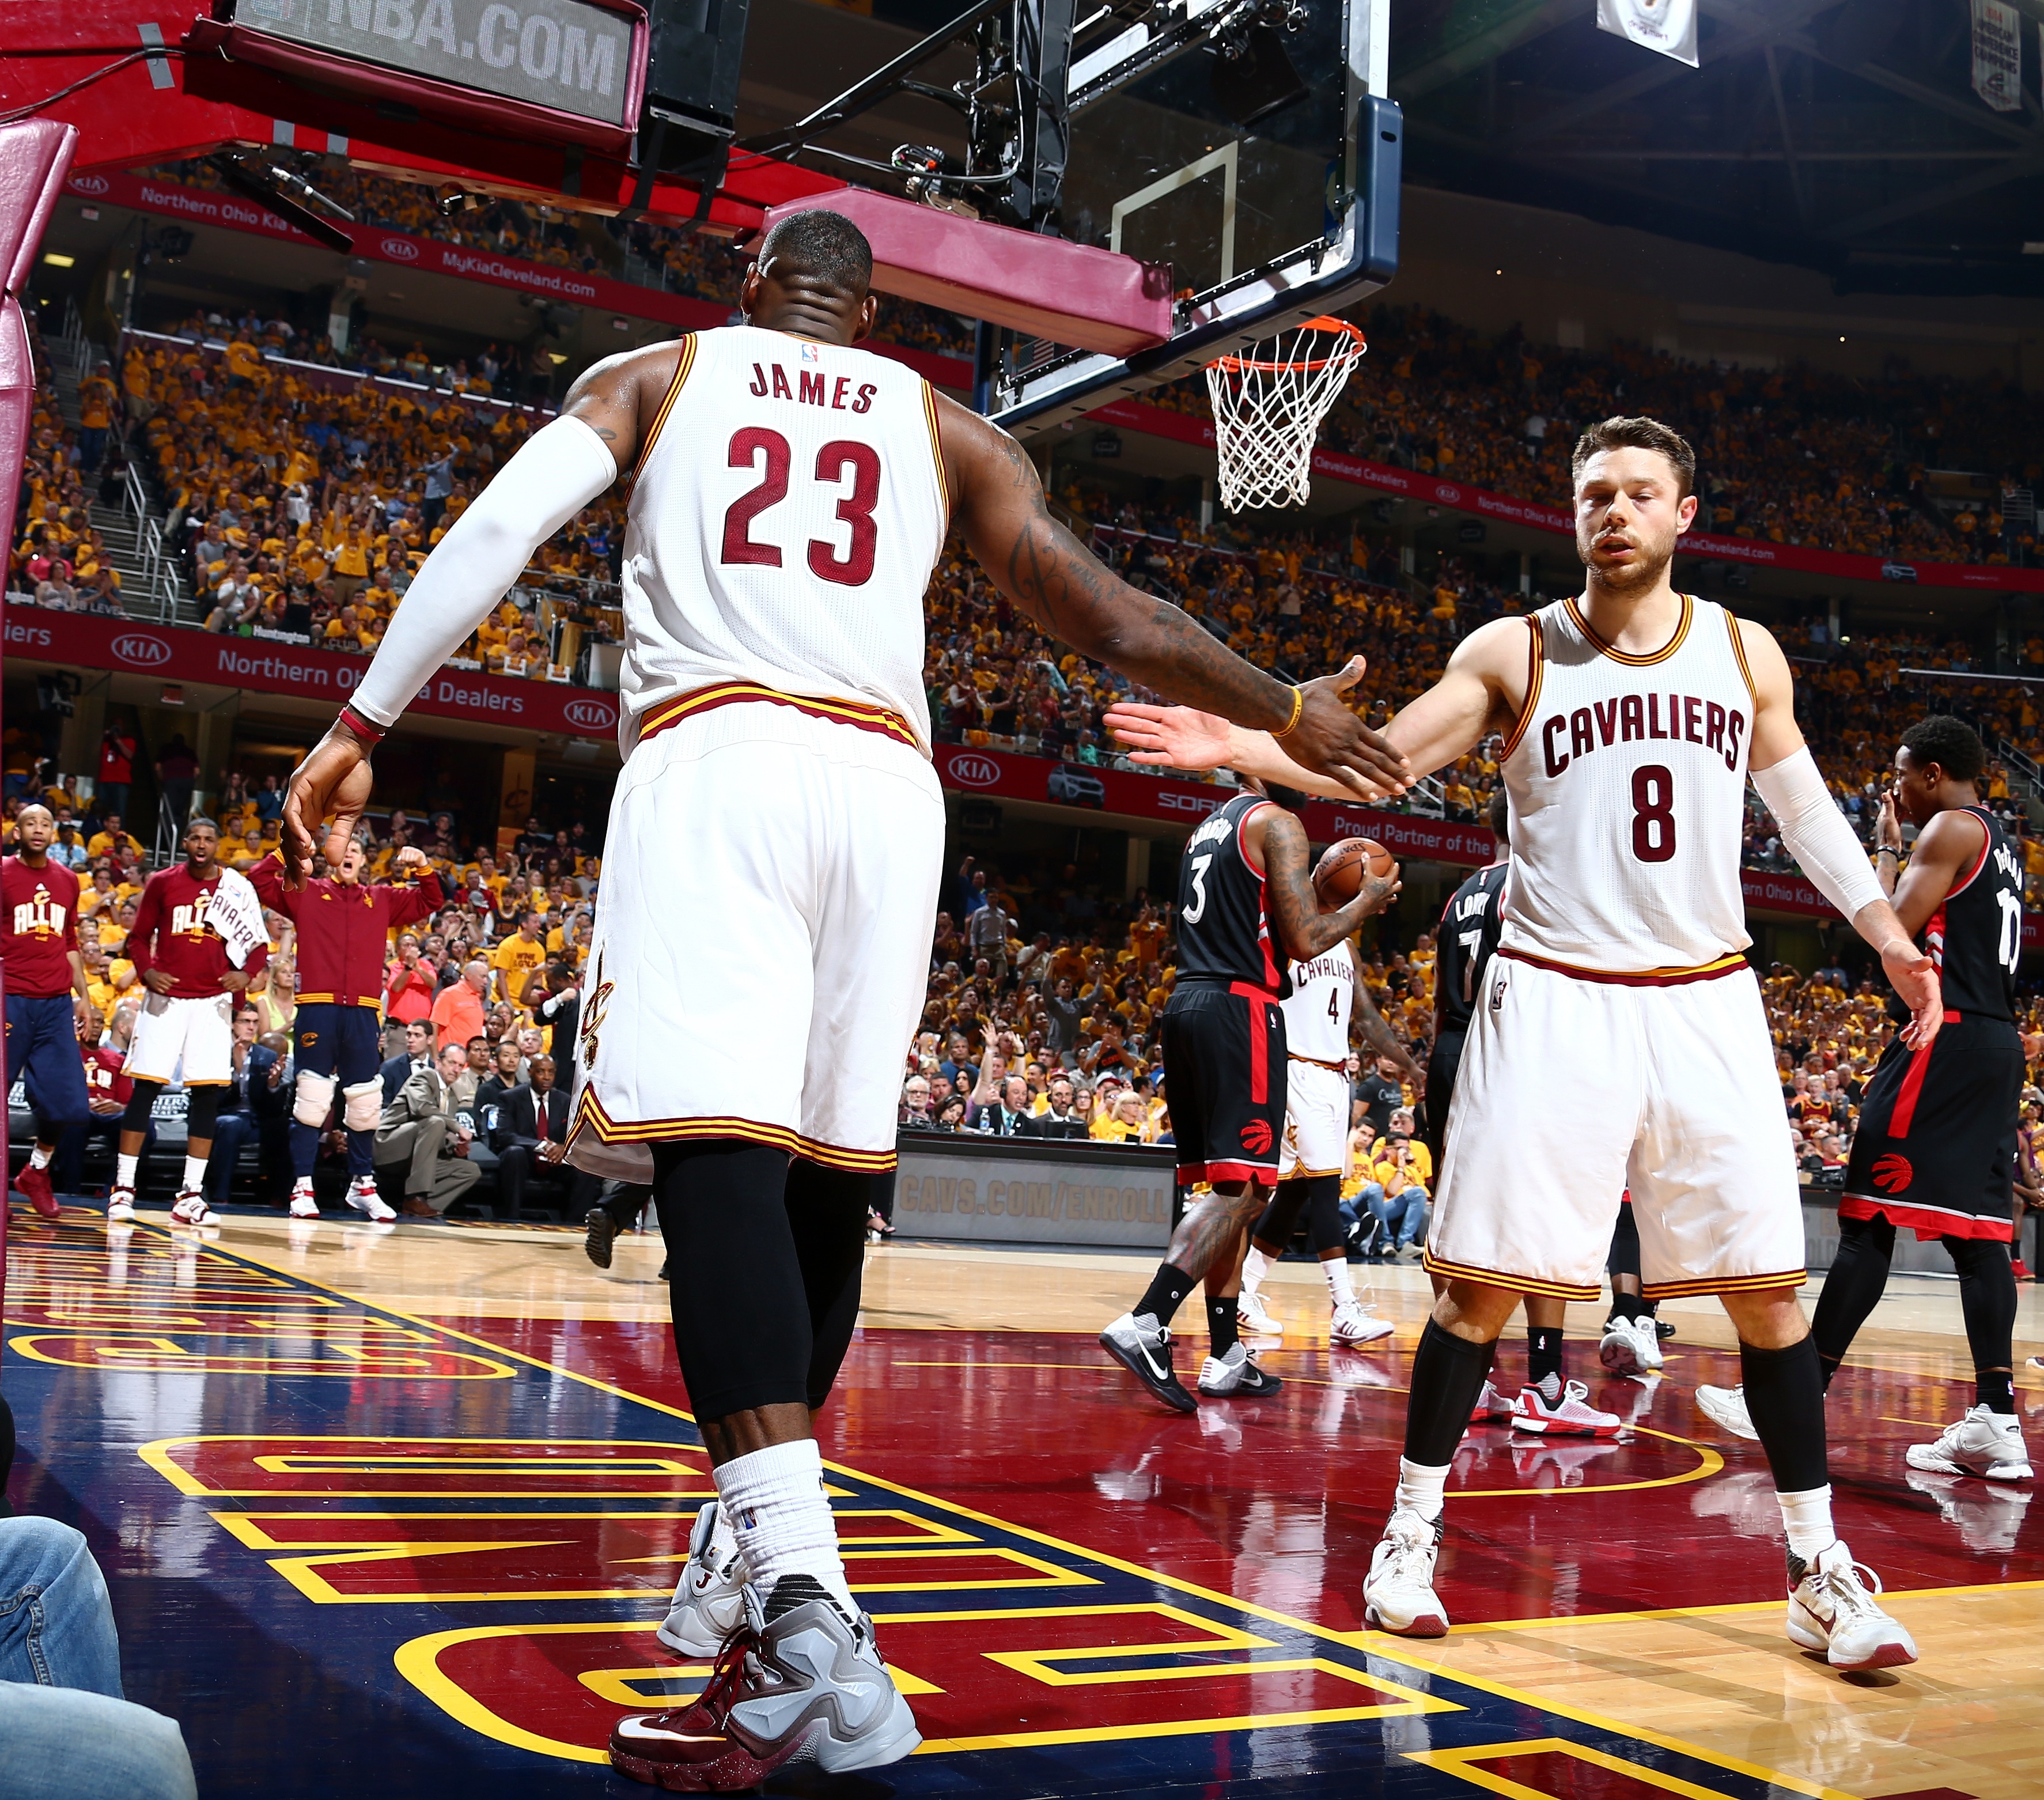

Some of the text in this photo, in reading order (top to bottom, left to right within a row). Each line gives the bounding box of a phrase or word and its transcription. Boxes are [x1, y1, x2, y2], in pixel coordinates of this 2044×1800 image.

[141, 187, 217, 216] Northern
[221, 204, 258, 225] Ohio
[442, 251, 596, 297] MyKiaCleveland.com
[750, 363, 877, 413] JAMES
[1314, 456, 1409, 489] Cleveland Cavaliers
[721, 426, 880, 586] 23
[1478, 495, 1523, 517] Northern
[1524, 508, 1546, 523] Ohio
[1547, 514, 1563, 527] Kia
[121, 639, 161, 661] KIA
[218, 649, 366, 689] Northern Oh
[438, 682, 524, 713] Dealers
[572, 705, 608, 724] KIA
[1543, 693, 1744, 778] CAVALIERS
[957, 762, 992, 781] KIA
[1632, 765, 1676, 862] 8
[1334, 816, 1381, 839] Proud
[1385, 824, 1441, 847] Partner
[1446, 834, 1462, 850] of
[1466, 840, 1490, 856] the
[1182, 853, 1213, 924] 3
[1766, 883, 1793, 902] Ohio
[1795, 888, 1814, 905] Kia
[1995, 886, 2022, 975] 10
[1458, 928, 1482, 1002] 7
[1327, 987, 1339, 1025] 4
[899, 1174, 1168, 1224] CAVS.COM/ENROLL
